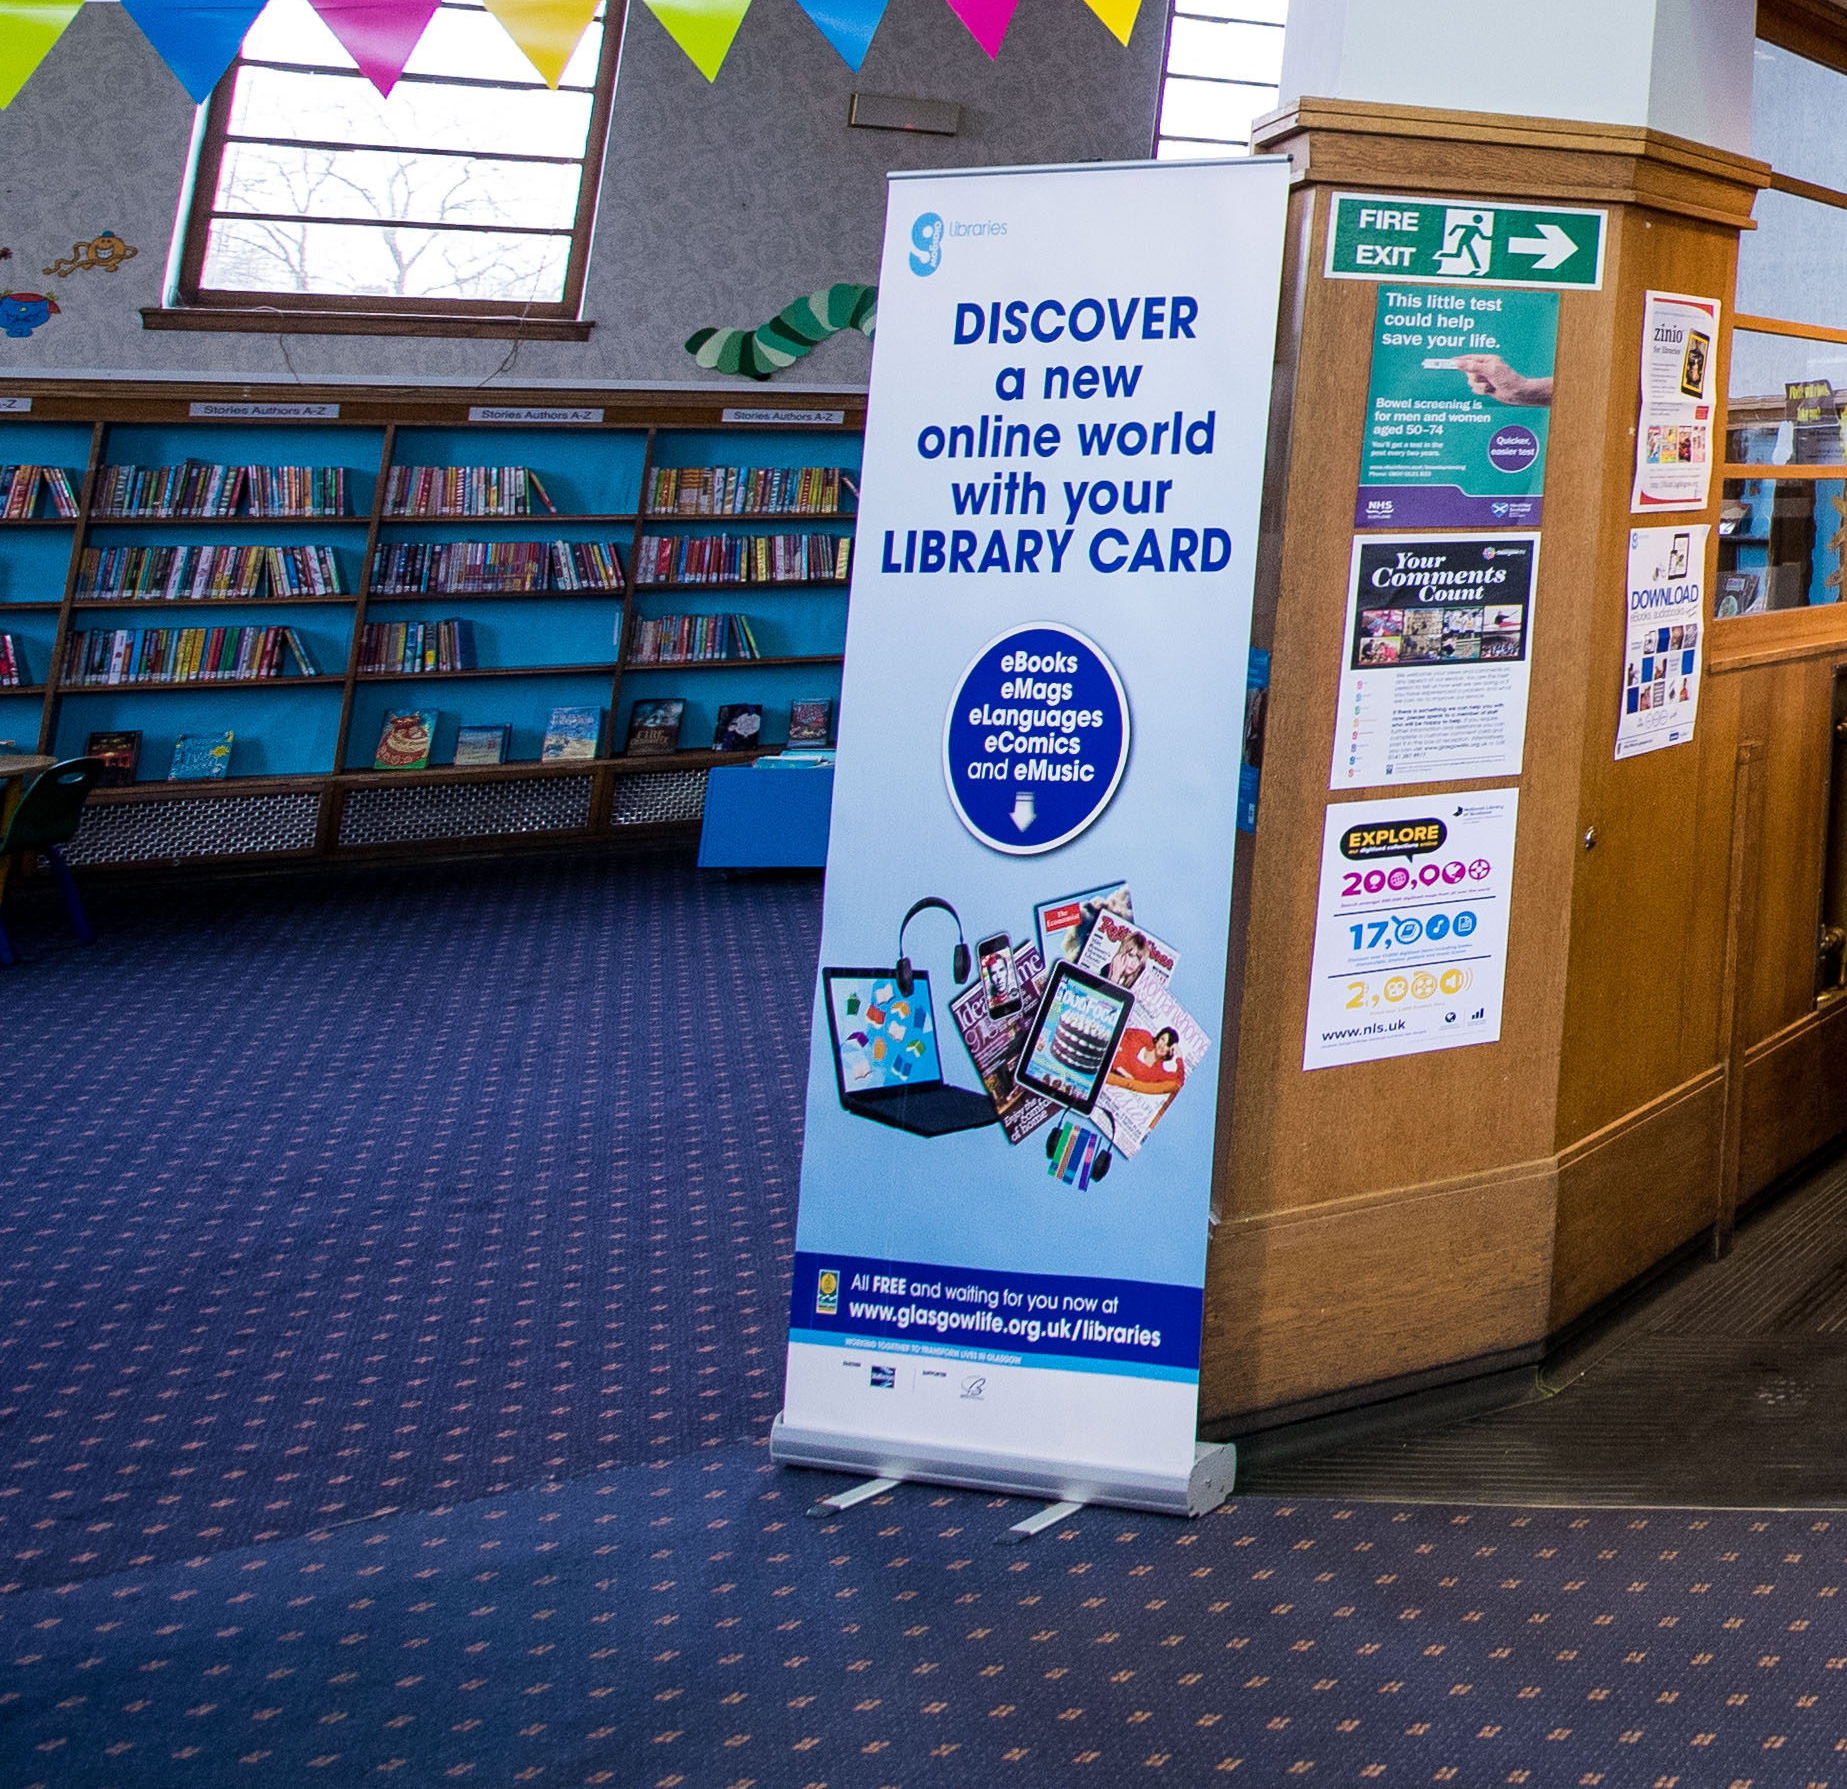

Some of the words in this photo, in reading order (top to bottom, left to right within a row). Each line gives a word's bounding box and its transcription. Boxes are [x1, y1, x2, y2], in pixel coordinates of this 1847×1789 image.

[949, 220, 1008, 238] libraries
[1359, 209, 1419, 231] FIRE
[1356, 245, 1416, 267] EXIT
[1386, 292, 1422, 308] This
[1427, 294, 1465, 309] little
[1471, 298, 1502, 311] test
[954, 296, 1199, 344] DISCOVER
[1384, 313, 1432, 327] could
[1437, 314, 1474, 331] help
[1382, 333, 1422, 346] save
[1426, 336, 1465, 349] your
[1469, 334, 1500, 348] life.
[1654, 323, 1684, 343] zinio
[996, 368, 1025, 401] a
[1043, 365, 1143, 399] new
[0, 399, 17, 409] -Z
[204, 405, 248, 415] Stories
[252, 406, 300, 415] Authors
[302, 406, 326, 416] A-Z
[1376, 397, 1412, 408] Bowel
[1414, 400, 1470, 411] screening
[1473, 400, 1482, 409] is
[481, 410, 521, 420] Stories
[524, 411, 568, 420] Authors
[571, 411, 592, 420] A-Z
[734, 411, 771, 421] Stories
[772, 412, 812, 422] Authors
[814, 413, 834, 422] A-Z
[1374, 411, 1392, 422] for
[1393, 413, 1421, 422] men
[1423, 412, 1445, 422] and
[1448, 414, 1491, 422] women
[918, 414, 1061, 459] online
[1078, 411, 1216, 456] world
[1373, 425, 1403, 436] aged
[1497, 436, 1531, 446] Quicker,
[1491, 448, 1518, 456] easier
[1519, 448, 1535, 456] test
[952, 471, 1046, 515] with
[1064, 479, 1172, 525] your
[1368, 501, 1392, 509] NHS
[881, 529, 1074, 573] LIBRARY
[1089, 528, 1232, 573] CARD
[1396, 552, 1446, 570] Your
[1371, 567, 1506, 587] Comments
[1418, 585, 1484, 603] Count
[1631, 584, 1699, 610] DOWNLOAD
[1001, 651, 1078, 673] eBooks
[1001, 678, 1073, 706] eMags
[969, 704, 1103, 733] eLanguages
[984, 731, 1081, 754] eComics
[968, 758, 1008, 780] and
[1014, 759, 1095, 781] eMusic
[1349, 825, 1439, 847] EXPLORE
[1322, 1019, 1406, 1041] www.nls.uk
[851, 1274, 869, 1291] All
[873, 1275, 906, 1295] FREE
[910, 1282, 941, 1298] and
[945, 1285, 999, 1308] waiting
[1003, 1288, 1023, 1306] for
[1028, 1295, 1058, 1312] you
[1062, 1296, 1098, 1312] now
[1102, 1297, 1118, 1314] at
[849, 1301, 1161, 1347] www.glasgowlife.org.uk/libraries
